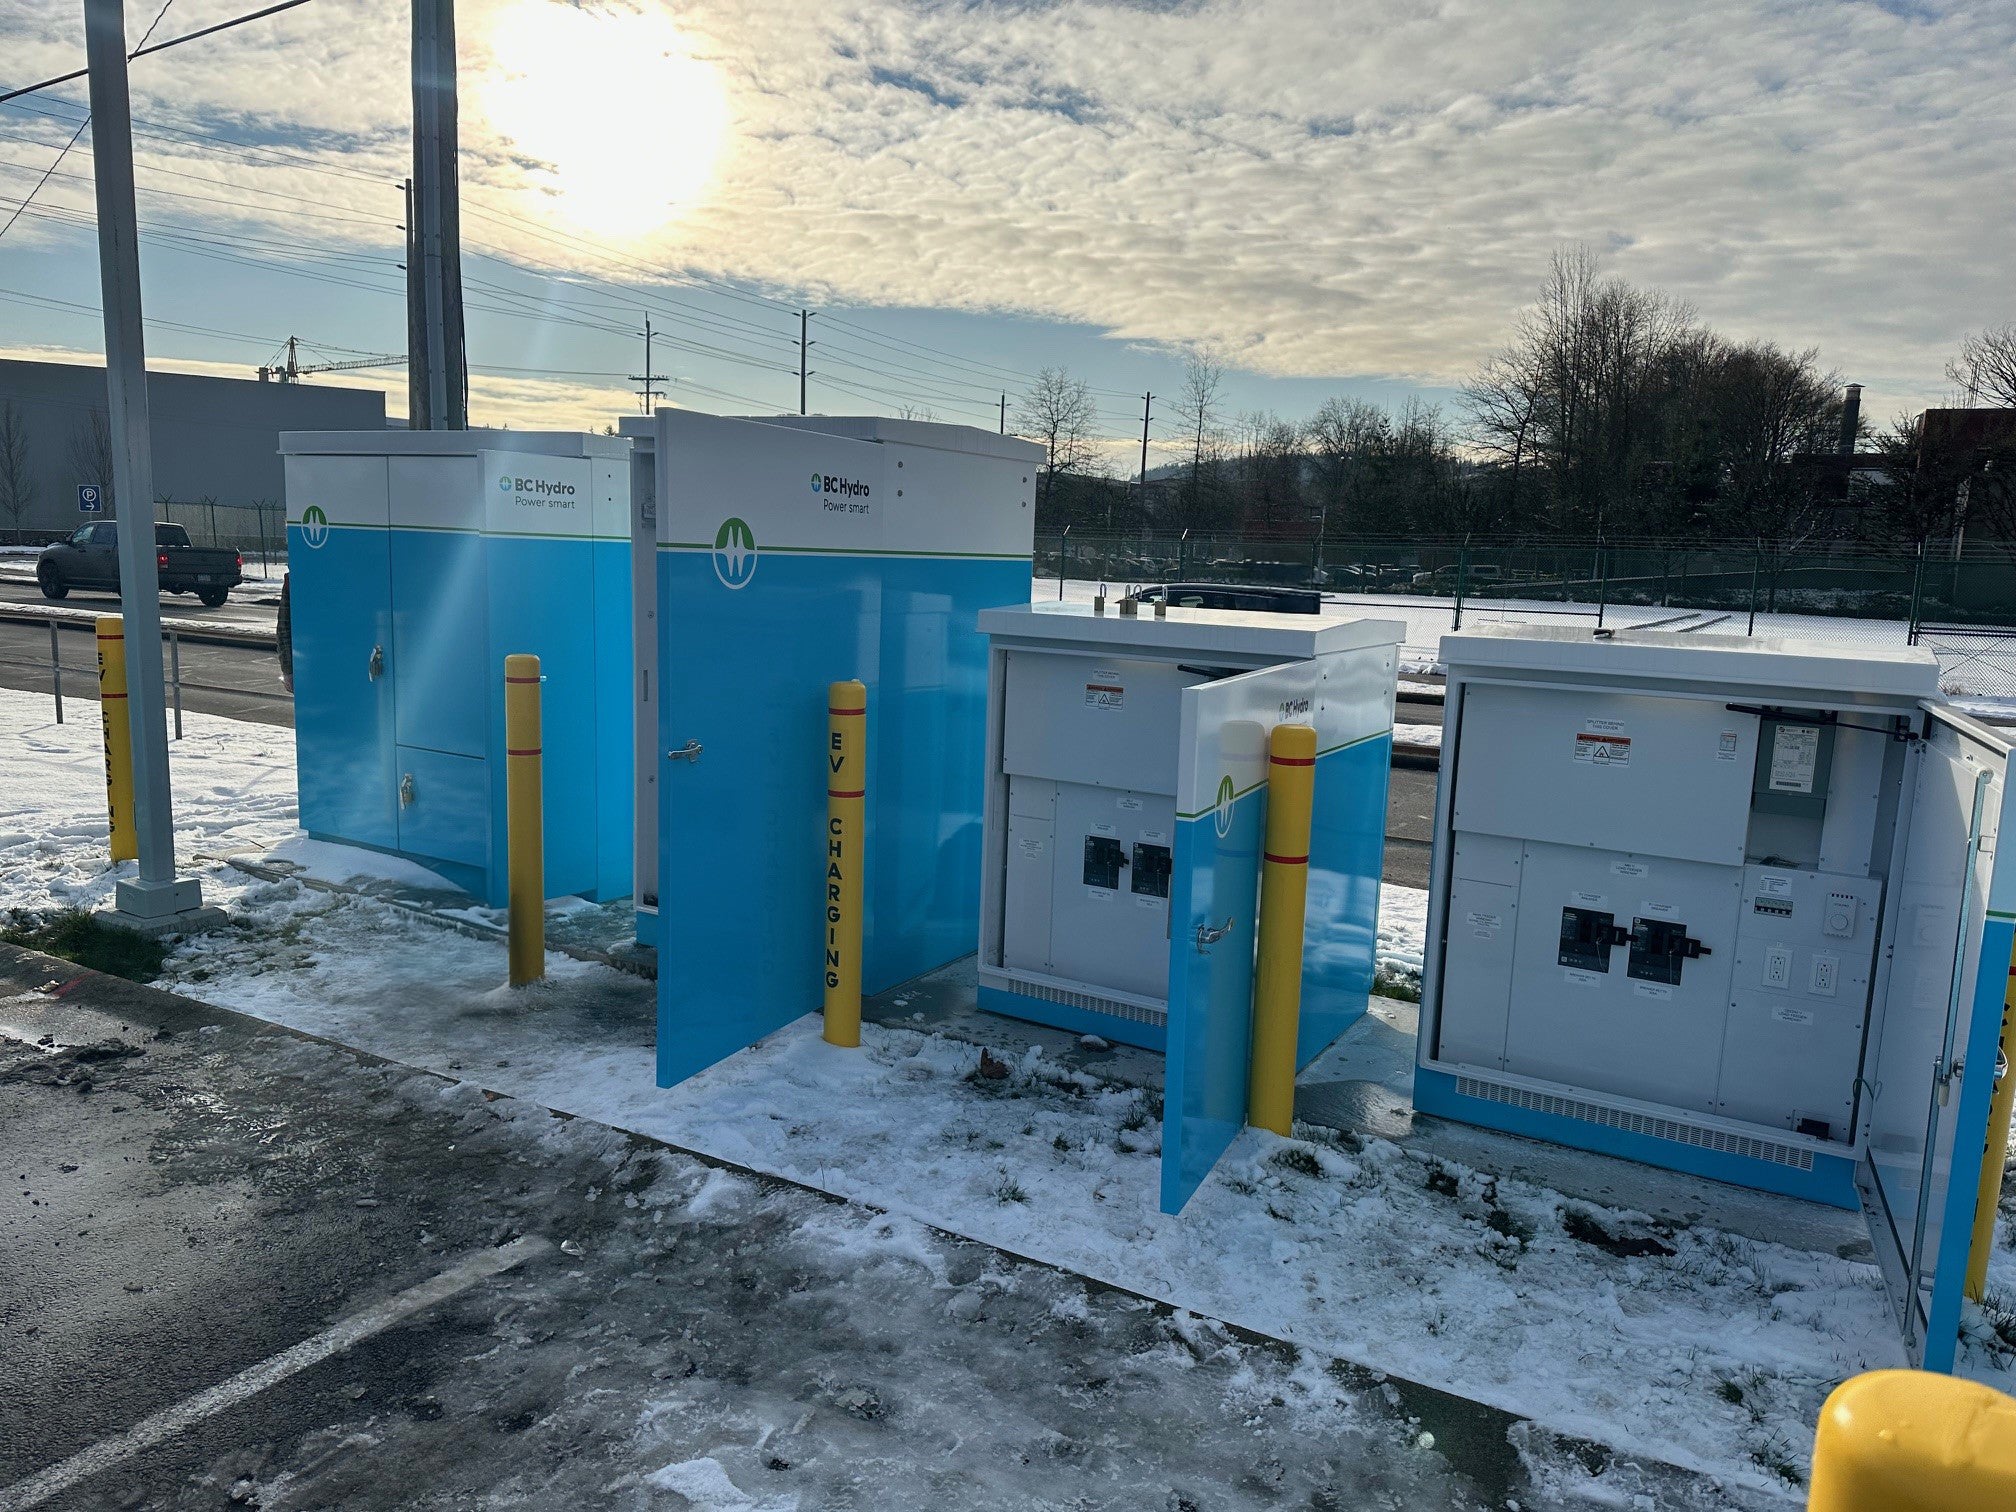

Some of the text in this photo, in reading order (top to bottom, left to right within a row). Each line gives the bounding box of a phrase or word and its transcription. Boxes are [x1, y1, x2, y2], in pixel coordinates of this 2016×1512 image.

[514, 478, 576, 496] BC Hydro
[824, 475, 870, 498] BC Hydro
[515, 495, 575, 510] Power smart
[823, 498, 870, 514] Power smart
[825, 732, 844, 988] EV CHARGING
